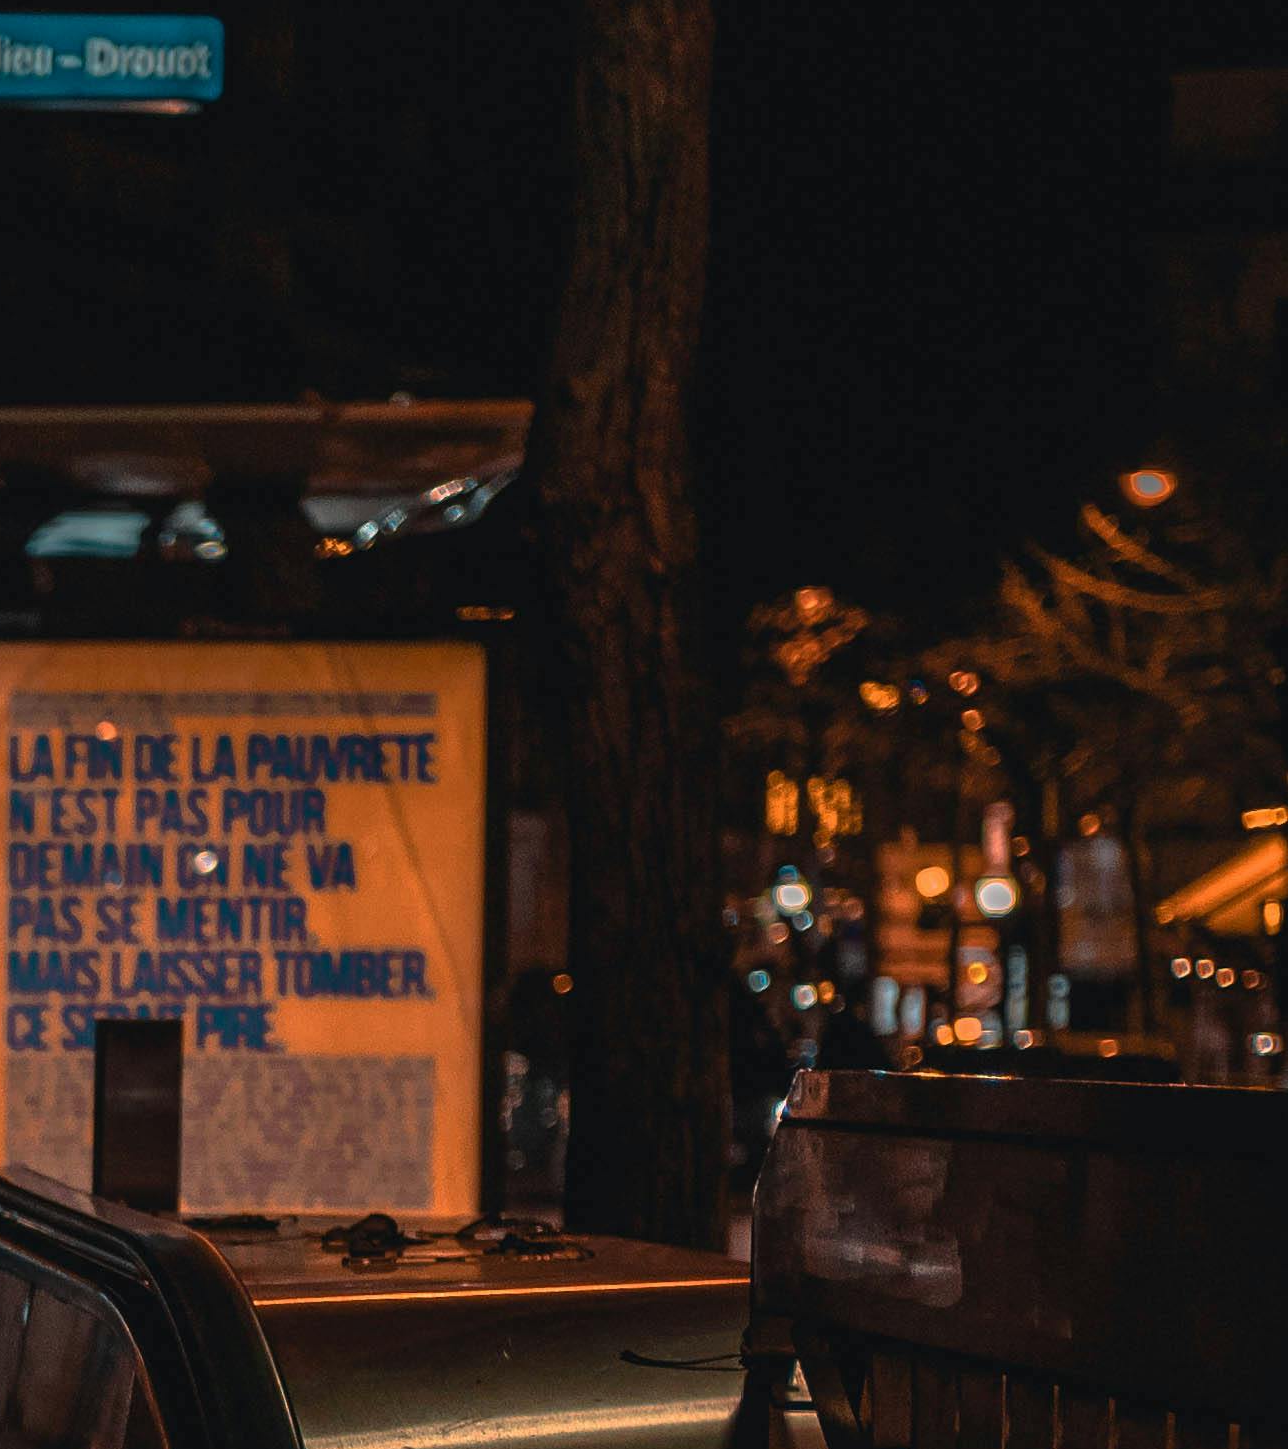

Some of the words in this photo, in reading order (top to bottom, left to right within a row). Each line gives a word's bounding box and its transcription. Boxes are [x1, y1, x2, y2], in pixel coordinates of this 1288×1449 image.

[84, 36, 213, 80] Drouot
[9, 734, 54, 781] LA
[65, 734, 123, 781] FIN
[134, 734, 179, 783] DE
[190, 734, 237, 783] LA
[135, 788, 210, 837] PAS
[222, 788, 326, 838] POUR
[243, 842, 291, 891] NE
[306, 842, 358, 891] VA
[8, 895, 83, 943] PAS
[95, 895, 142, 944] SE
[8, 950, 101, 998] MAIS
[111, 950, 263, 998] LAISSER
[7, 1004, 51, 1051] CE
